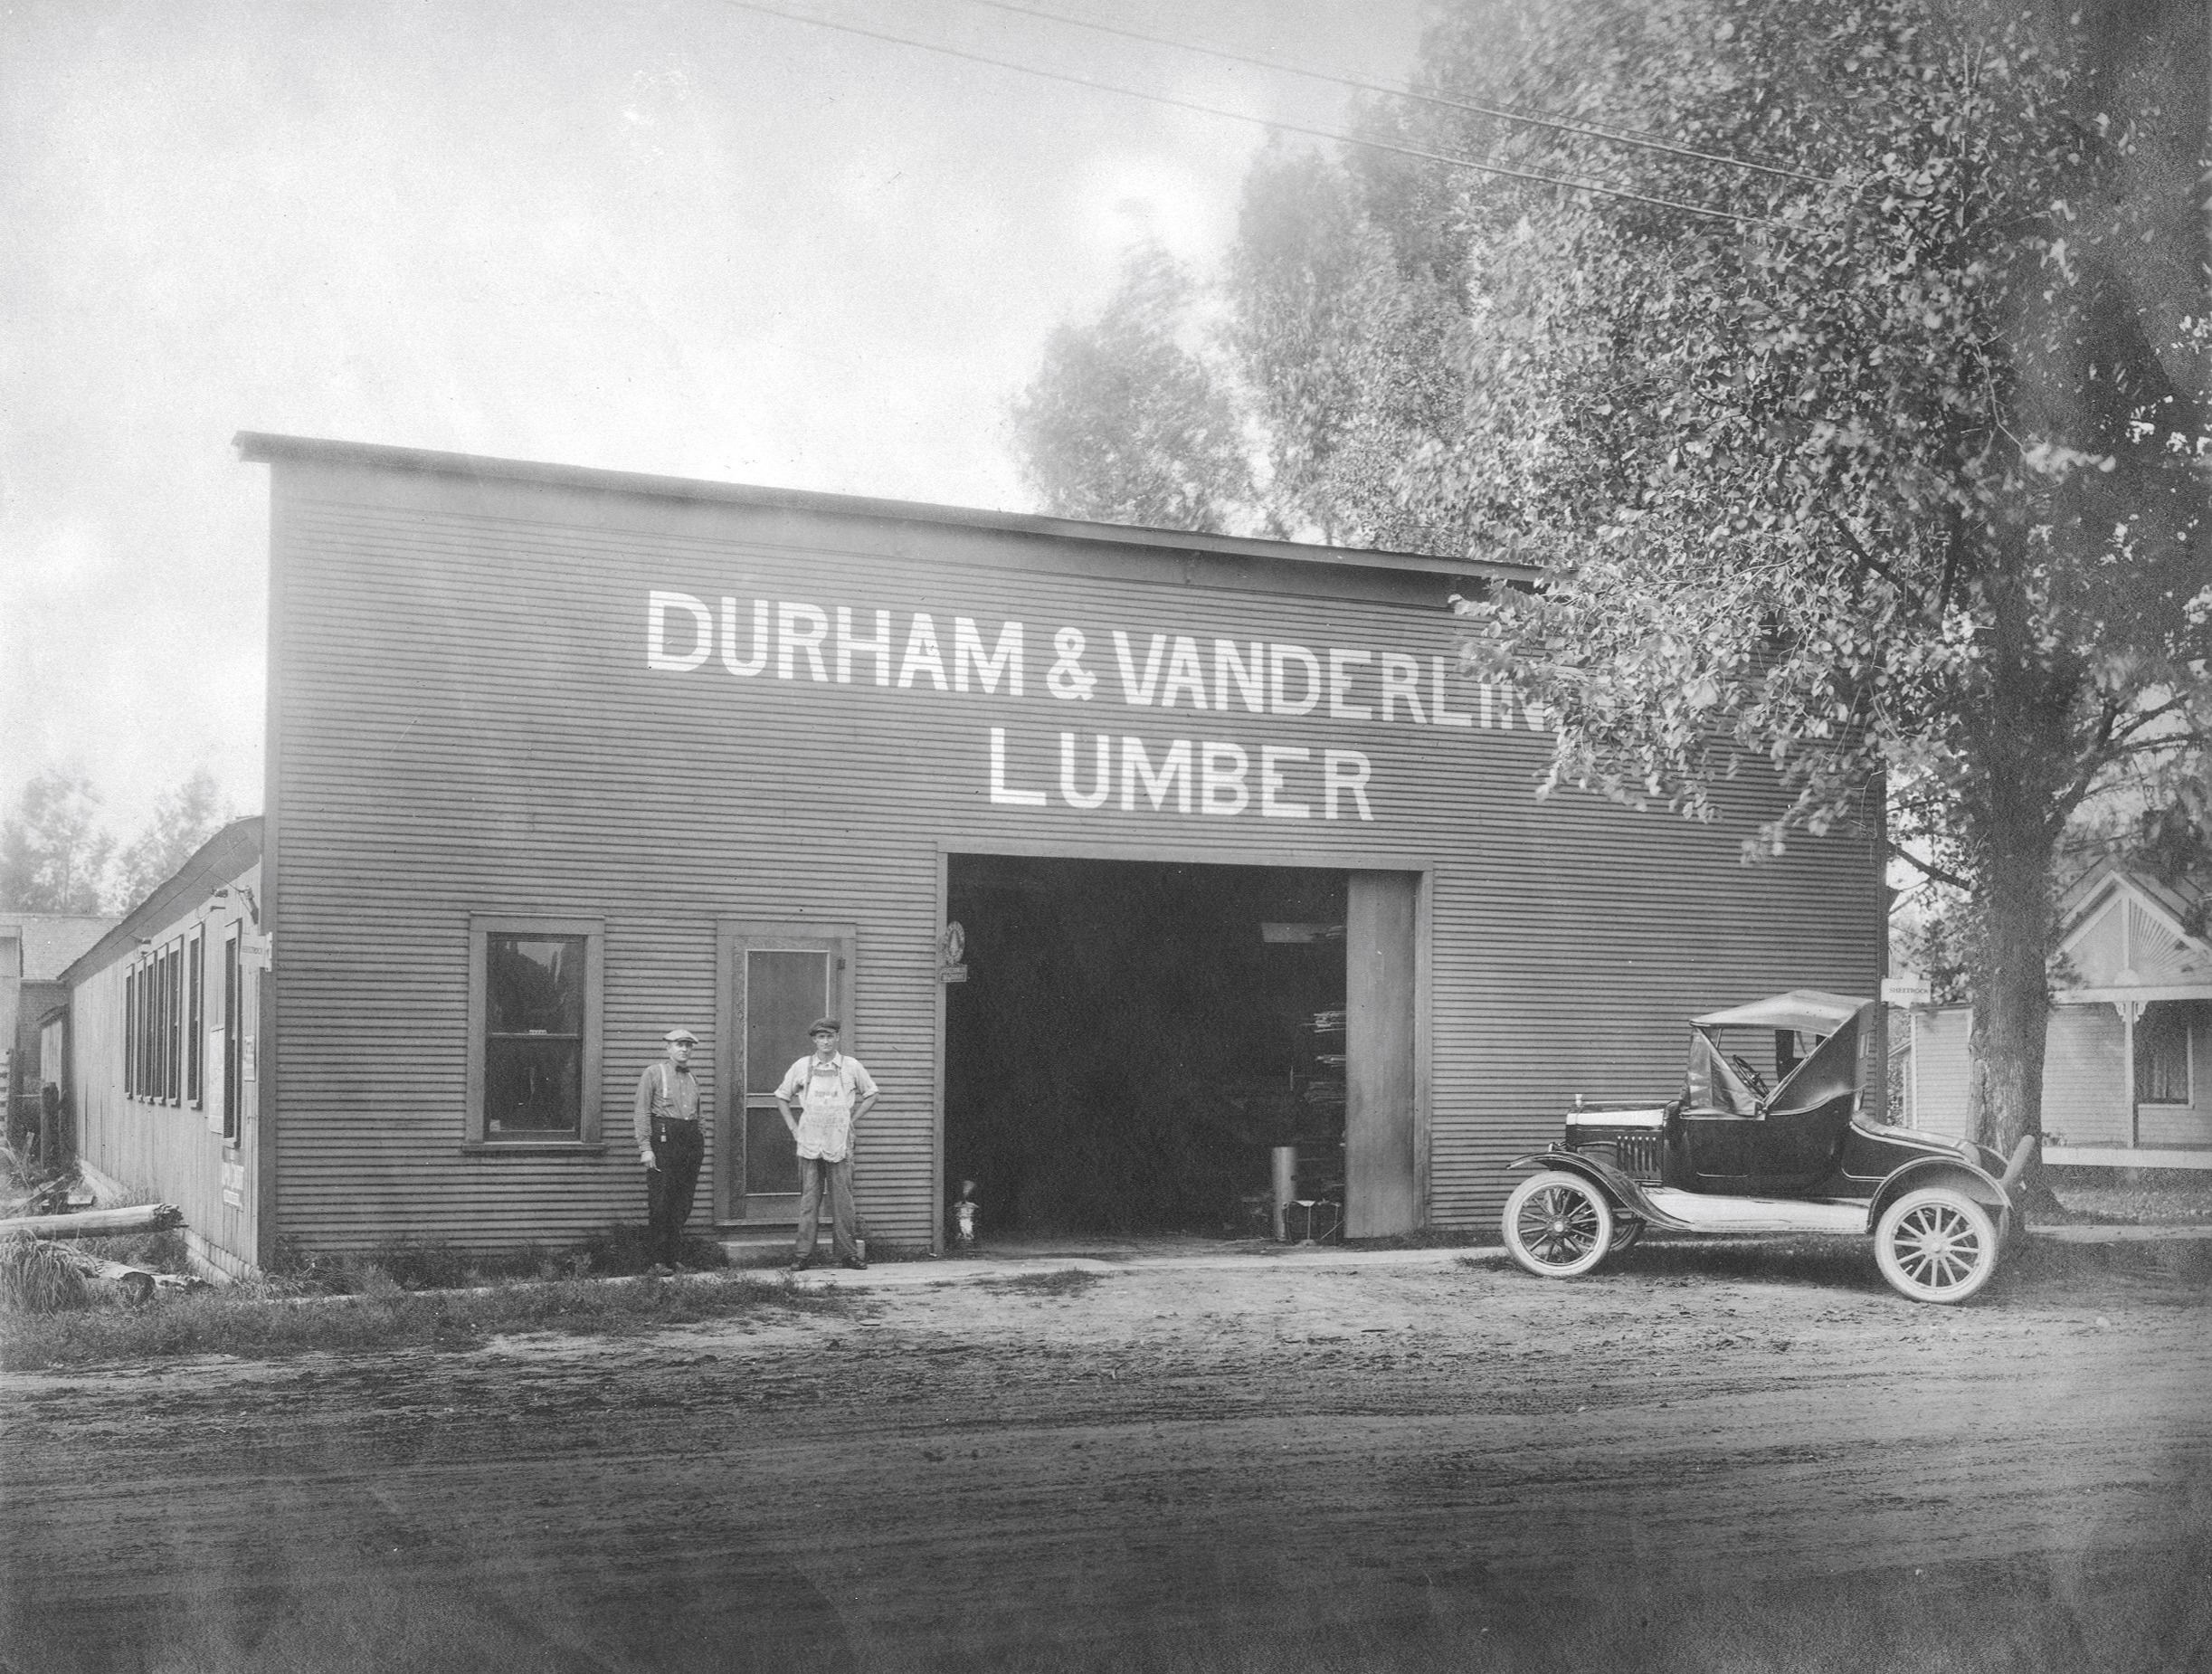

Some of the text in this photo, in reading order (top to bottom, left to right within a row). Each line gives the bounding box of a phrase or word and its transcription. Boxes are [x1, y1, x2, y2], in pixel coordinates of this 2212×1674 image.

[647, 590, 1563, 732] DURHAM & VANDERLIN
[990, 728, 1374, 821] LUMBER
